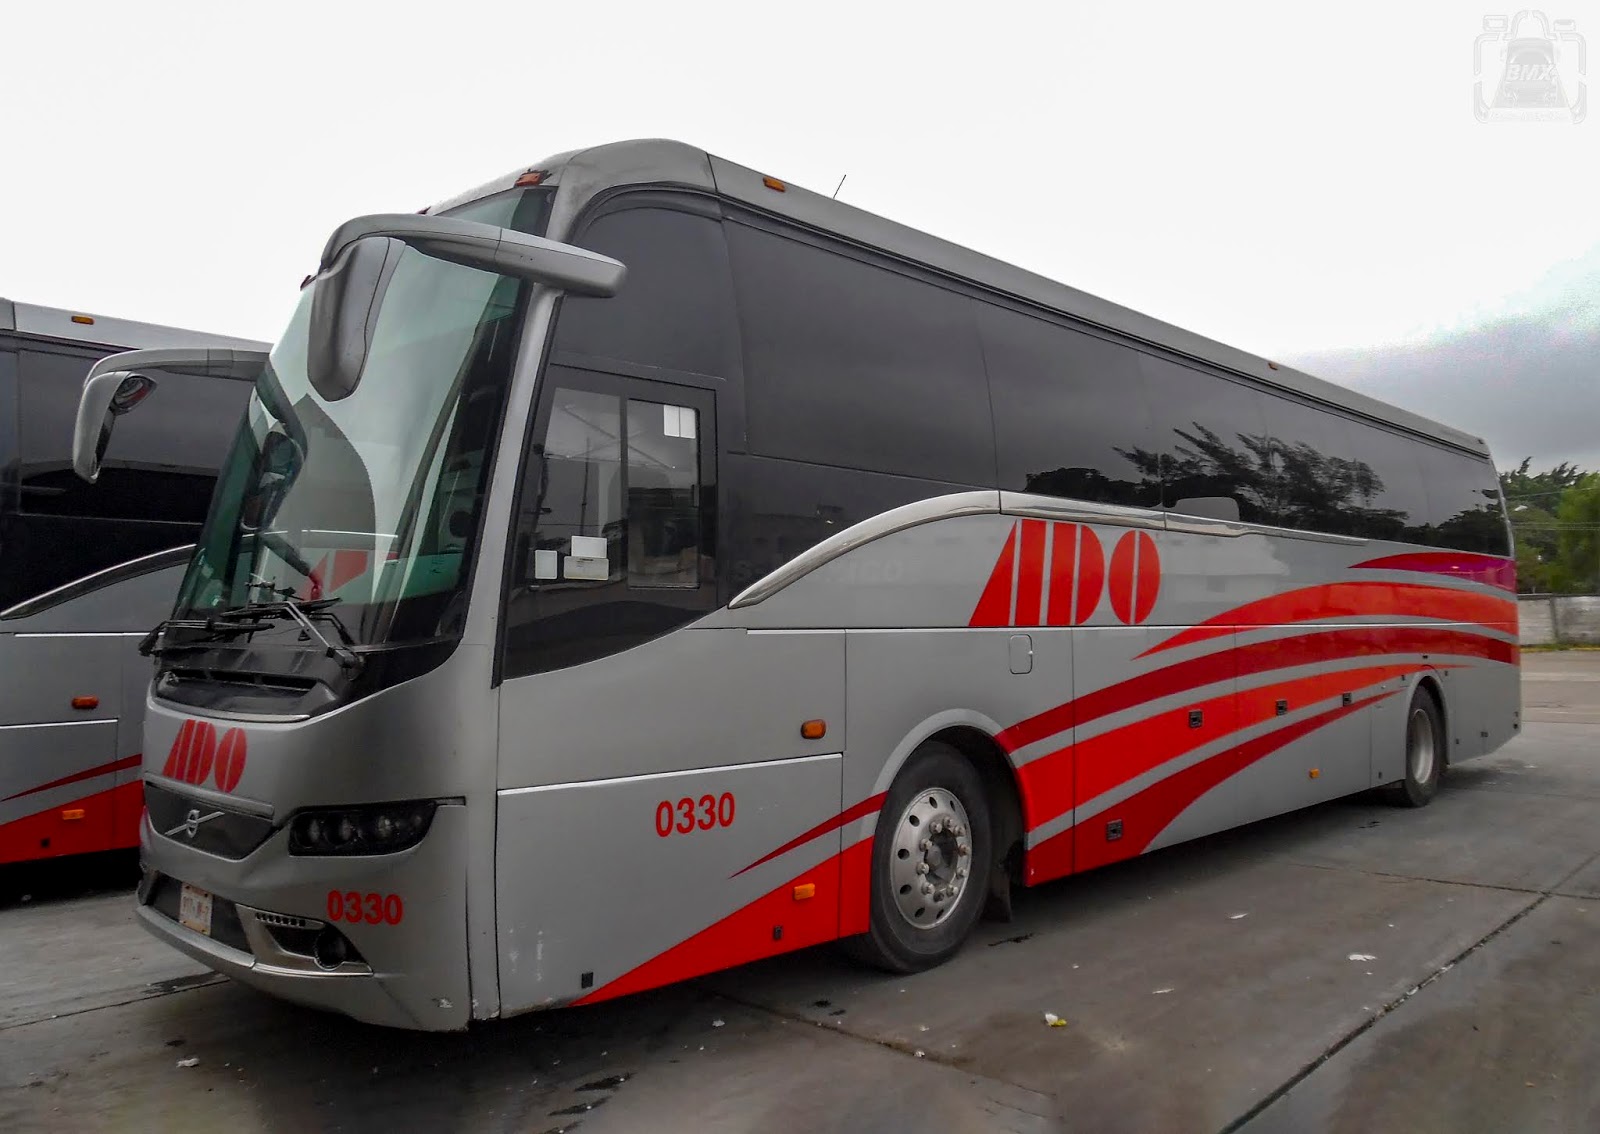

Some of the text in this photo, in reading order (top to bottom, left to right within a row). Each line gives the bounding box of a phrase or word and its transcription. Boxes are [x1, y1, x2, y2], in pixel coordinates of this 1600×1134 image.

[968, 518, 1161, 627] ADO
[162, 718, 247, 793] ADO
[655, 791, 736, 838] 0330
[327, 889, 404, 926] 0330
